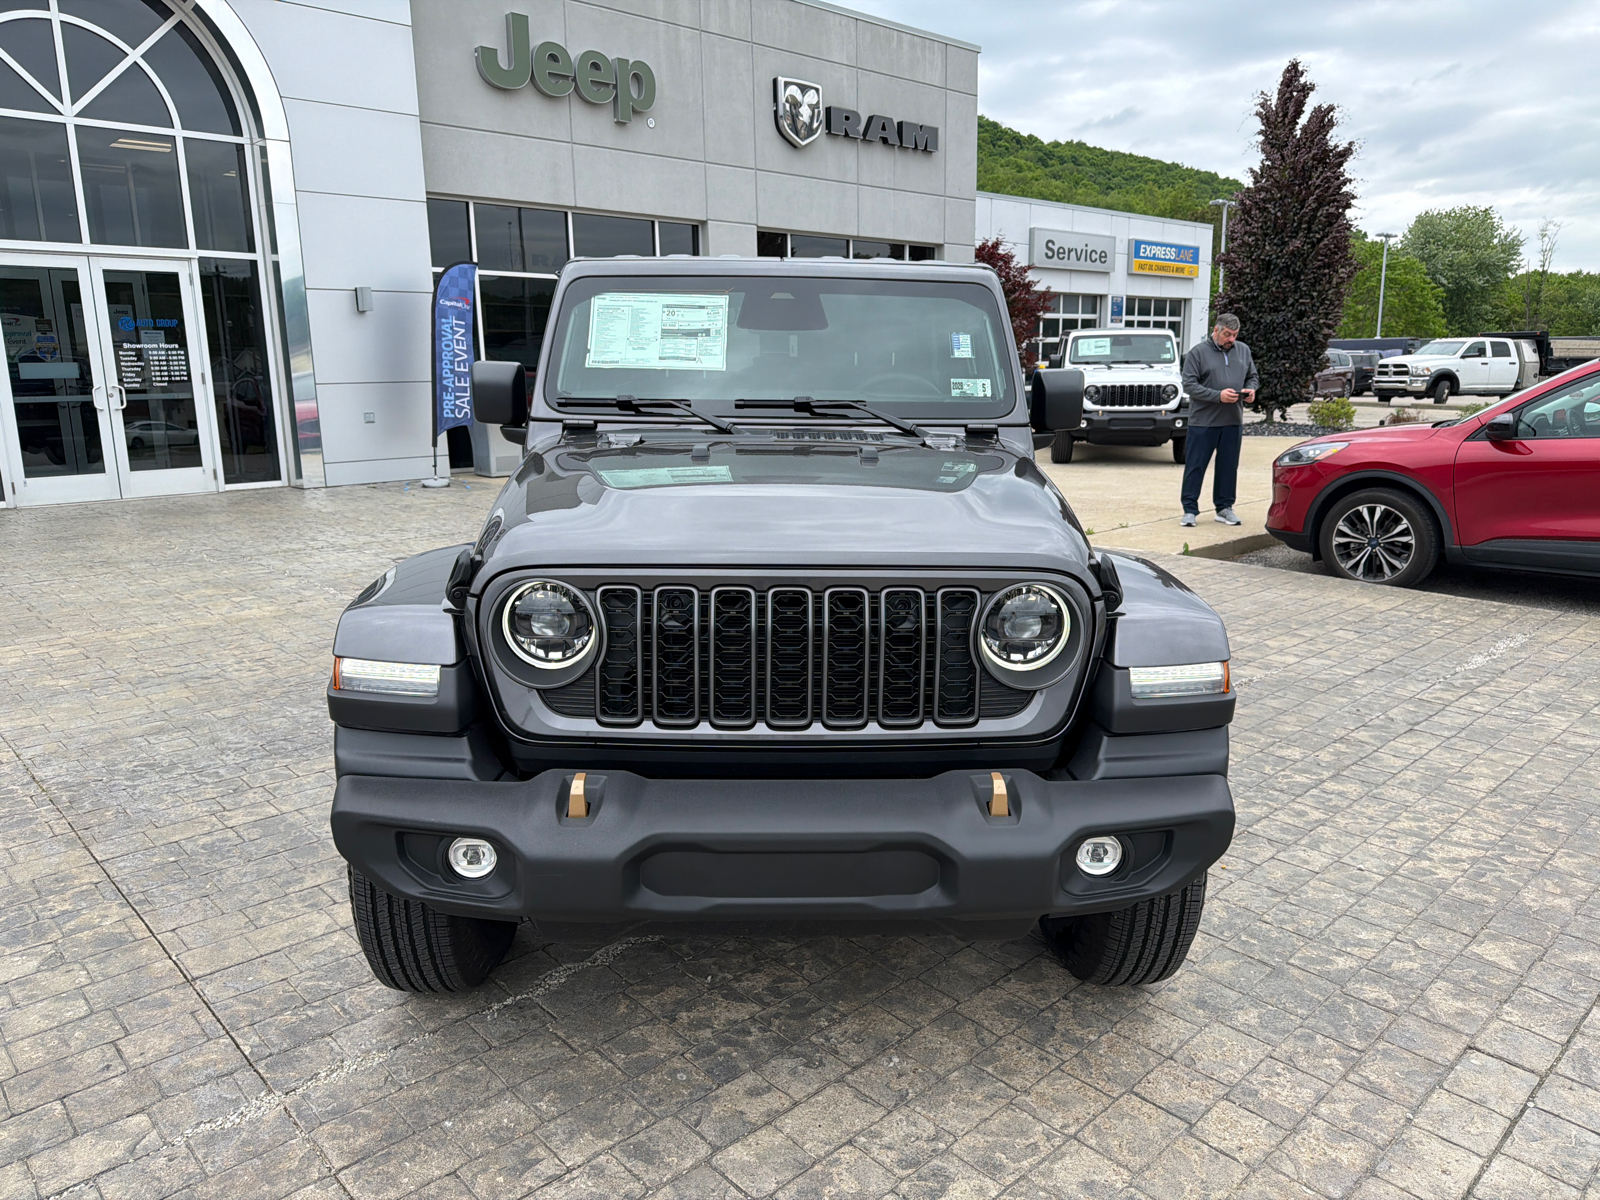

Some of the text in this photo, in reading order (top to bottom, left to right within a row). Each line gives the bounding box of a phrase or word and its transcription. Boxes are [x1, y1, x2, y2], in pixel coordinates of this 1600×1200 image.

[475, 12, 656, 124] Jeep
[825, 106, 939, 152] RAM
[1044, 239, 1108, 264] Service
[1154, 265, 1172, 273] CHANGES
[136, 319, 154, 327] AUTO
[156, 319, 178, 327] GROUP
[442, 315, 455, 418] PRE-APPROVAL
[453, 316, 471, 419] SALE EVENT
